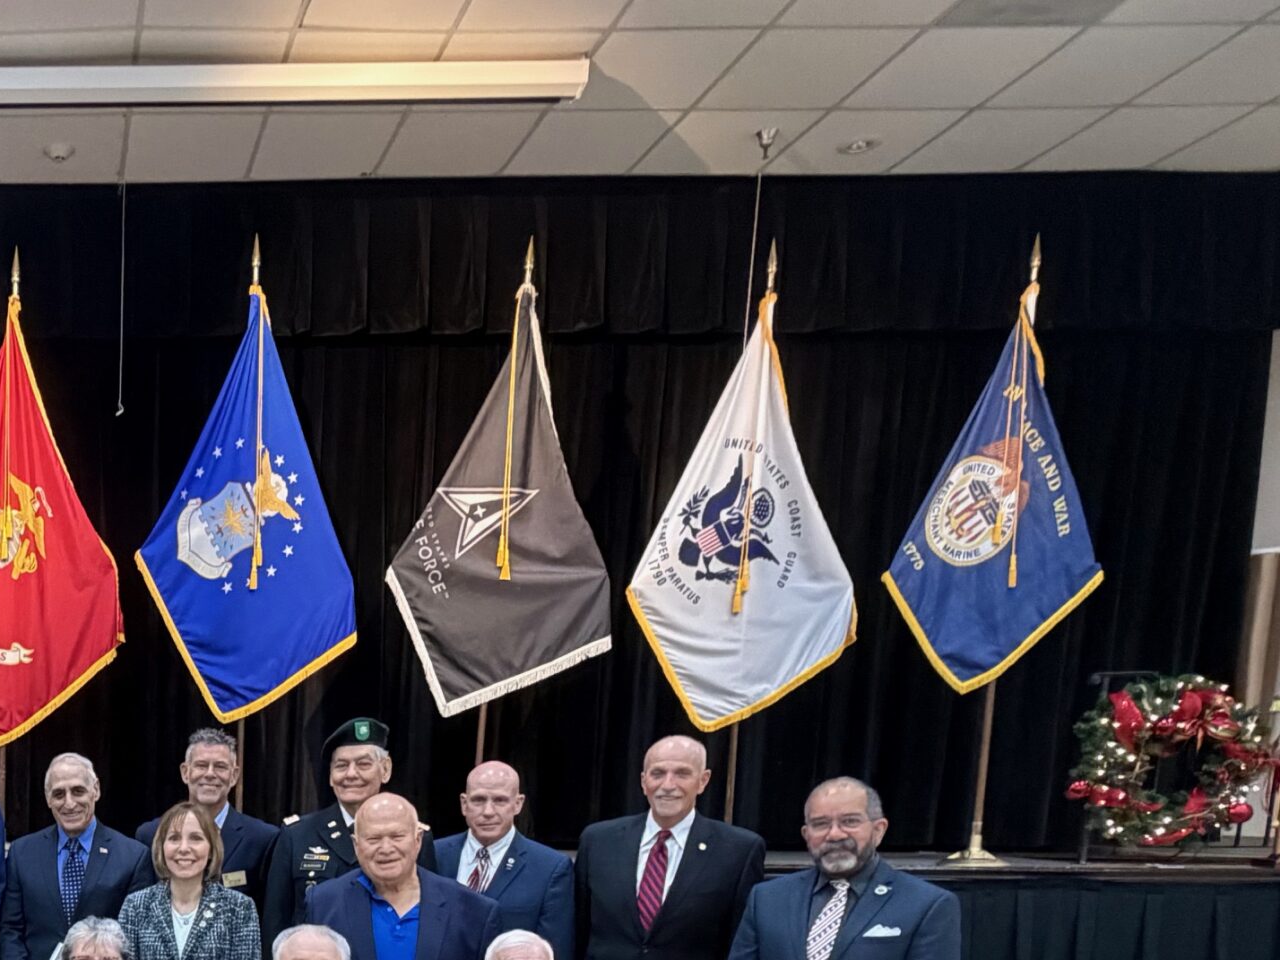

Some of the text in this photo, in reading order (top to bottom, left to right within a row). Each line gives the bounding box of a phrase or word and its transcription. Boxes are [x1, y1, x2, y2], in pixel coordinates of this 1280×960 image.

[763, 454, 790, 490] TATES
[962, 463, 996, 476] UNITED
[1037, 454, 1062, 492] AND
[1053, 494, 1071, 538] WAR
[787, 499, 802, 538] COAST
[930, 480, 981, 560] MERCHANT MARINE
[414, 535, 447, 595] FORCE
[648, 558, 667, 587] 1790
[656, 516, 701, 605] SEMPER PARATUS
[777, 551, 797, 589] GUARD
